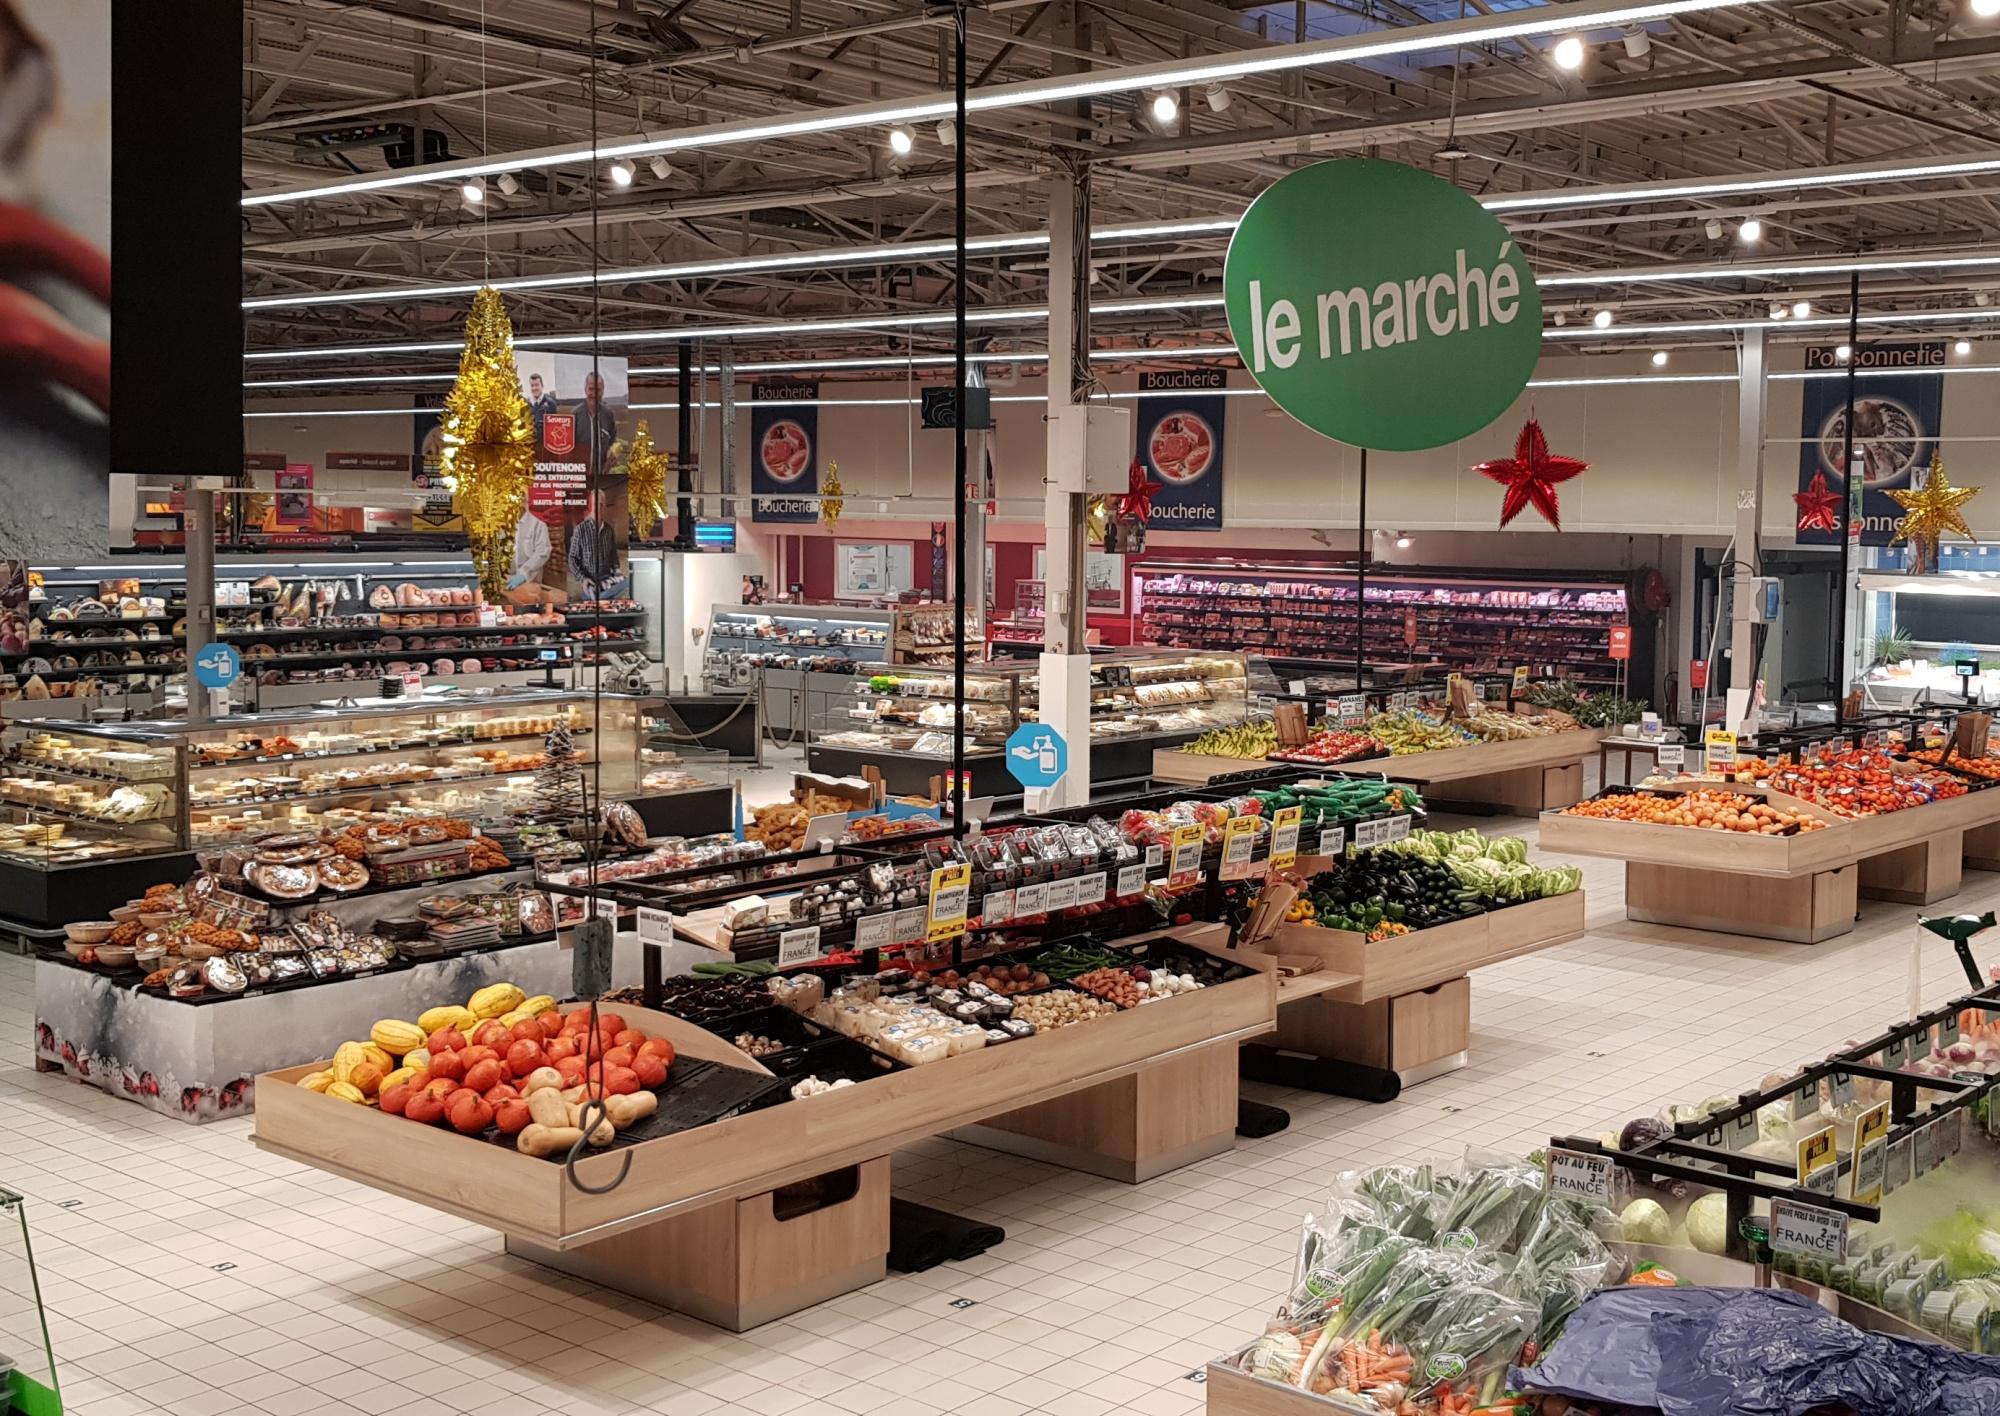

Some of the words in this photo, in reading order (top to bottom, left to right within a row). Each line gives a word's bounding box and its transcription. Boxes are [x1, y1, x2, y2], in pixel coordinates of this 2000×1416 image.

[1249, 280, 1302, 374] le
[1316, 241, 1520, 360] marché
[1147, 370, 1221, 388] Boucherie
[758, 385, 813, 399] Boucherie
[533, 462, 587, 473] SOUTENONS
[783, 948, 813, 959] FRANCE
[1551, 1154, 1570, 1167] POT
[1571, 1158, 1585, 1169] AU
[1587, 1160, 1605, 1173] FEU
[1552, 1175, 1603, 1195] FRANCE
[1776, 1227, 1835, 1252] FRANCE
